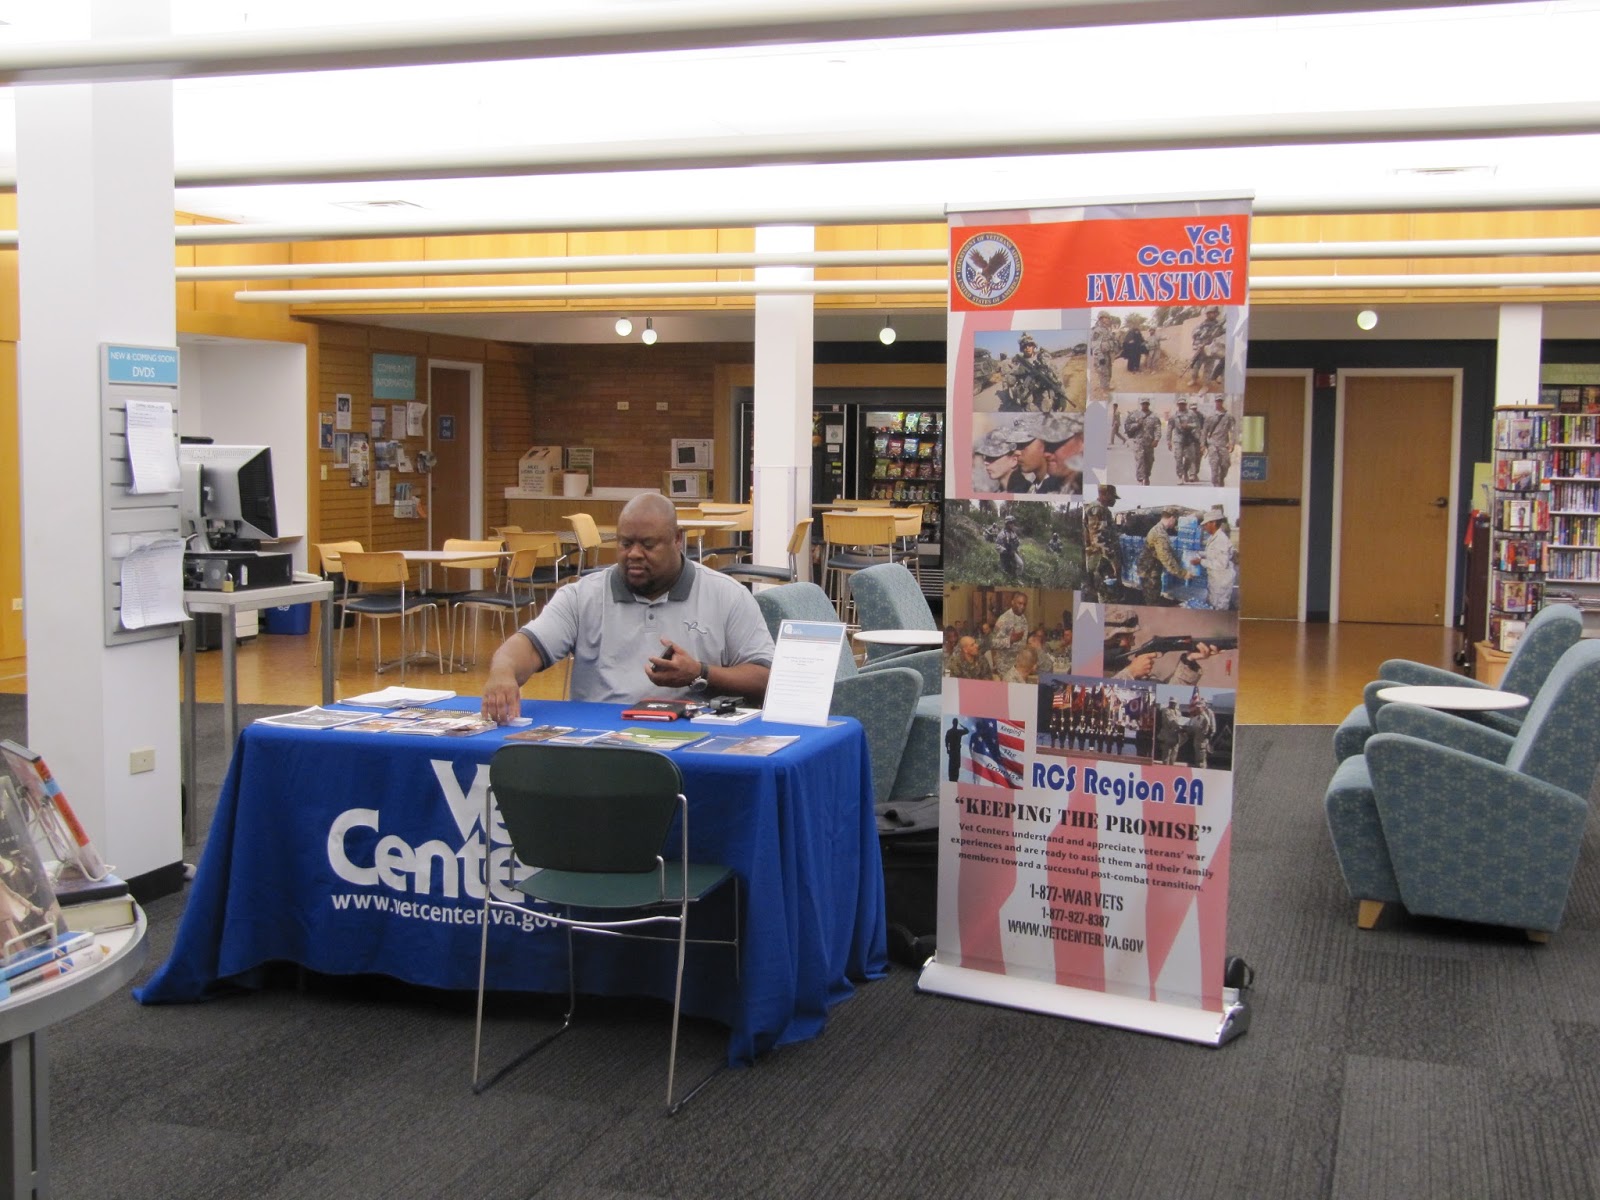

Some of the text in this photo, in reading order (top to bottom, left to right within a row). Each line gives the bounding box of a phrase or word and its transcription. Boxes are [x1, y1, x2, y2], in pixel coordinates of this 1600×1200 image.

[985, 234, 1012, 249] VETERANS
[1184, 223, 1232, 246] Vet
[1136, 244, 1233, 267] Center
[1086, 271, 1233, 302] EVANSTON
[110, 351, 176, 363] NEW & COMING SOON
[132, 366, 156, 378] DVDS
[1242, 470, 1260, 479] Only
[1000, 724, 1022, 737] Keeping
[1032, 762, 1204, 806] RCS Region 2A
[430, 758, 515, 846] Ve
[955, 796, 1212, 842] “KEEPING THE PROMISE”
[327, 807, 548, 904] Cente
[959, 822, 974, 832] Vet
[976, 824, 1010, 837] Centers
[1012, 831, 1065, 844] understand
[1066, 837, 1085, 846] and
[1086, 840, 1136, 854] appreciate
[1186, 853, 1206, 862] war
[951, 837, 1002, 850] experiences
[1004, 845, 1022, 853] and
[1041, 849, 1067, 861] ready
[1068, 852, 1079, 860] to
[1081, 854, 1106, 864] assist
[1108, 857, 1132, 868] them
[1134, 862, 1154, 871] and
[1156, 864, 1180, 874] their
[1182, 866, 1214, 880] family
[958, 852, 999, 864] members
[1001, 858, 1034, 869] toward
[1043, 863, 1089, 876] successful
[1091, 869, 1150, 886] post-combat
[1151, 877, 1204, 892] transition.
[1029, 883, 1124, 912] 1-877-WAR VETS
[1008, 919, 1144, 954] WWW.VETCENTER.VA.GOV
